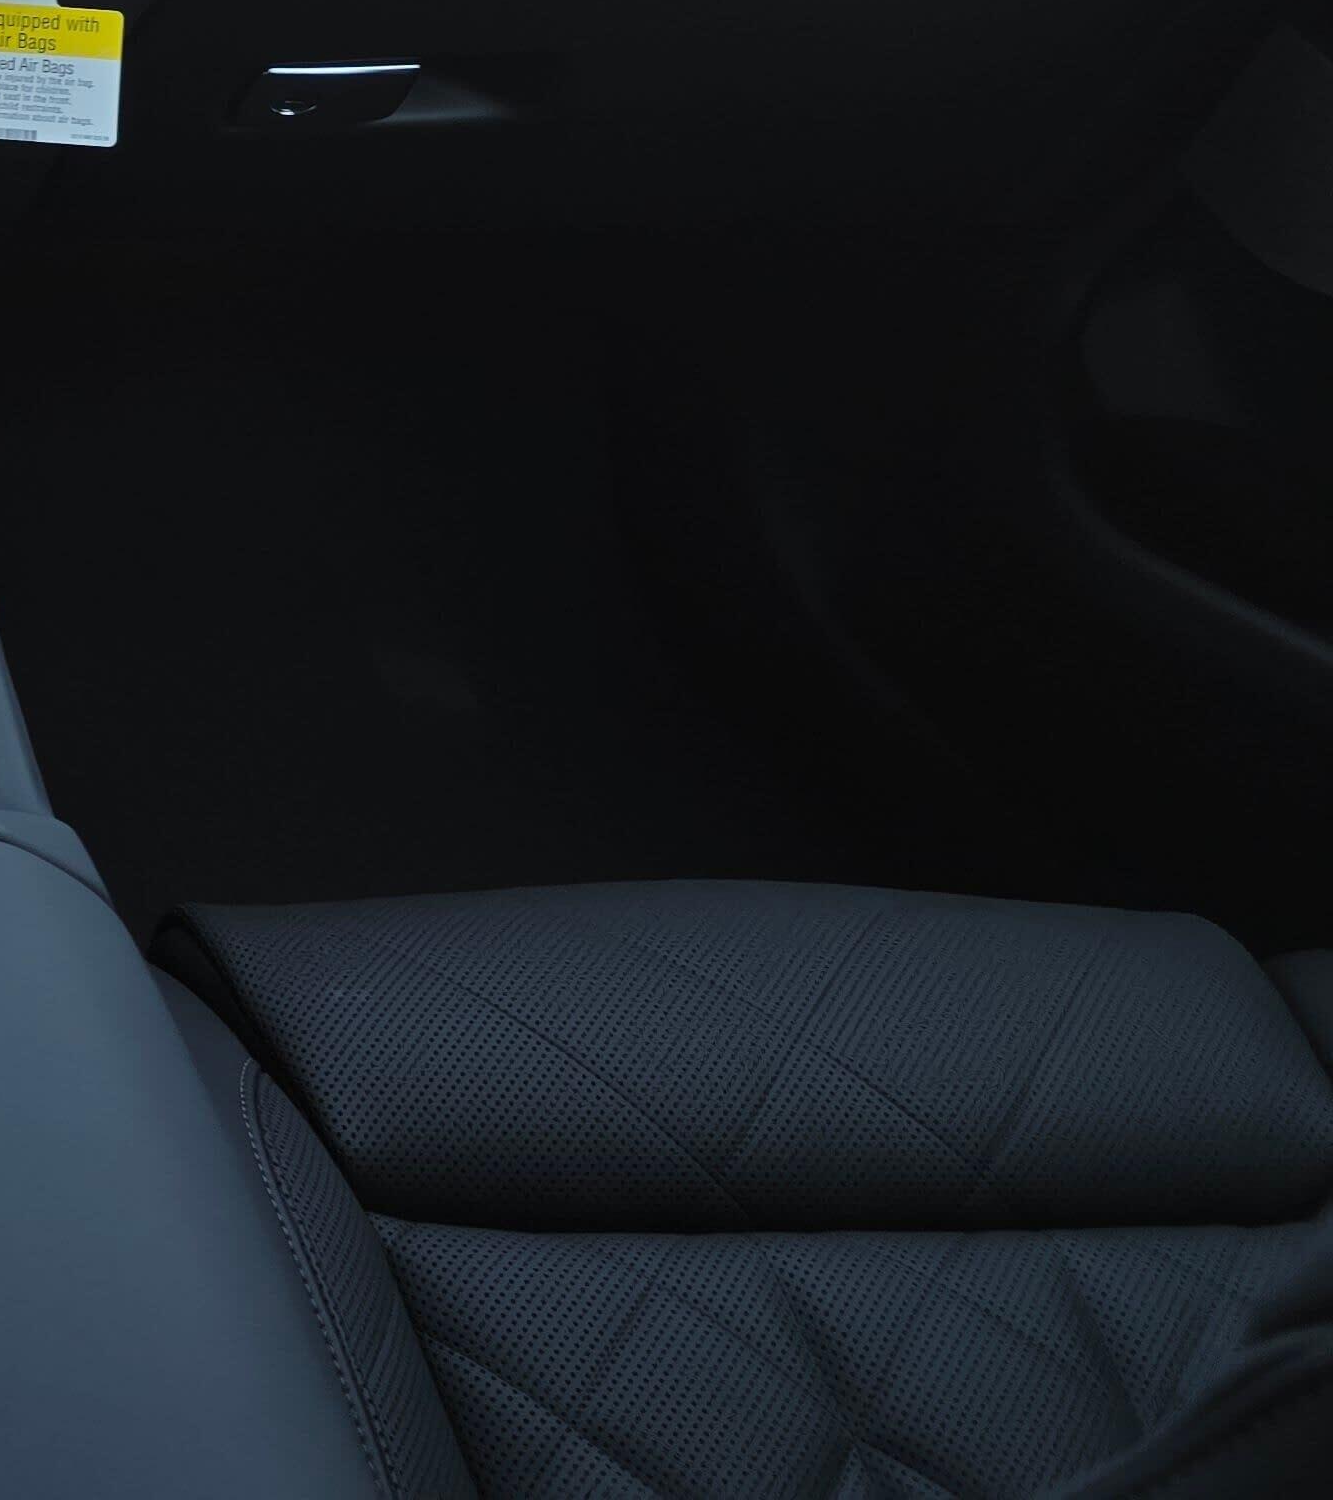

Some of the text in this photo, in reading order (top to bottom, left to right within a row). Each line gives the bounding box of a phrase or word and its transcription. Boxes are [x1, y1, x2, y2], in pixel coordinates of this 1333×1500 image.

[66, 15, 100, 32] with
[18, 32, 57, 53] Bags
[19, 58, 39, 72] Air
[42, 59, 75, 77] Bags
